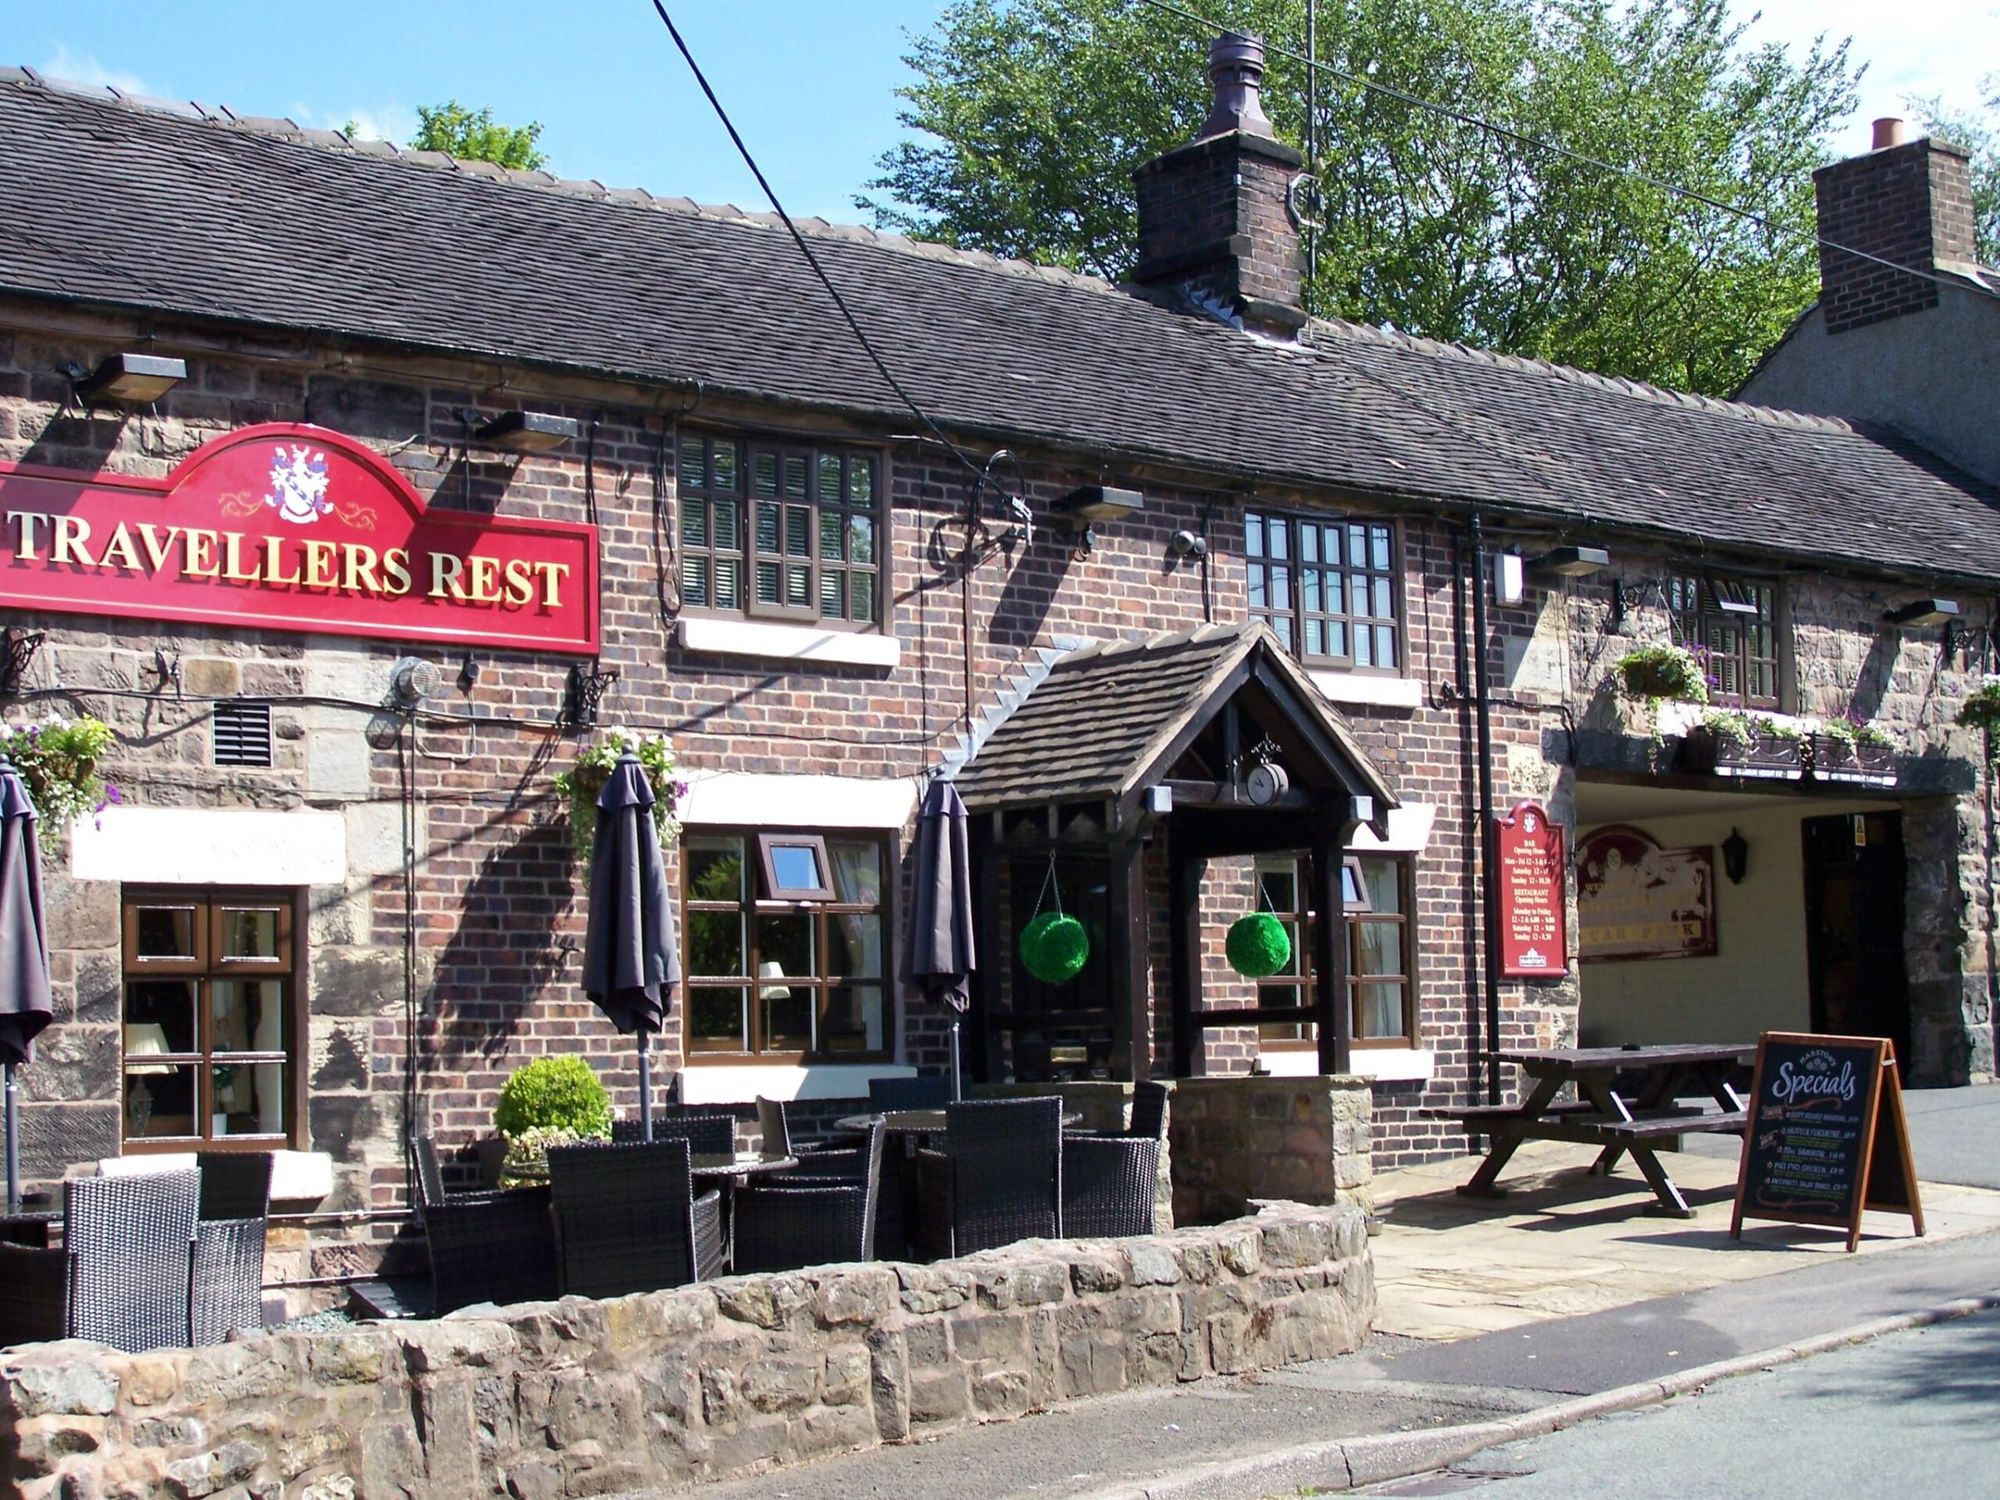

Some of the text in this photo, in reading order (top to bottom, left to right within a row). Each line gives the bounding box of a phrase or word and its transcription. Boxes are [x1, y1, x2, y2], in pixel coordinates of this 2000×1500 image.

[6, 510, 569, 606] TRAVELLERS REST
[1514, 847, 1532, 855] Opening
[1512, 867, 1532, 876] Saturday
[1511, 876, 1527, 885] Sunday
[1514, 888, 1549, 896] RESTAURANT
[1515, 896, 1534, 904] Opening
[1513, 907, 1531, 916] Monday
[1537, 908, 1551, 916] Friday
[1512, 924, 1532, 933] Saturday
[1514, 933, 1531, 942] Sunday
[1772, 1060, 1856, 1104] Specials
